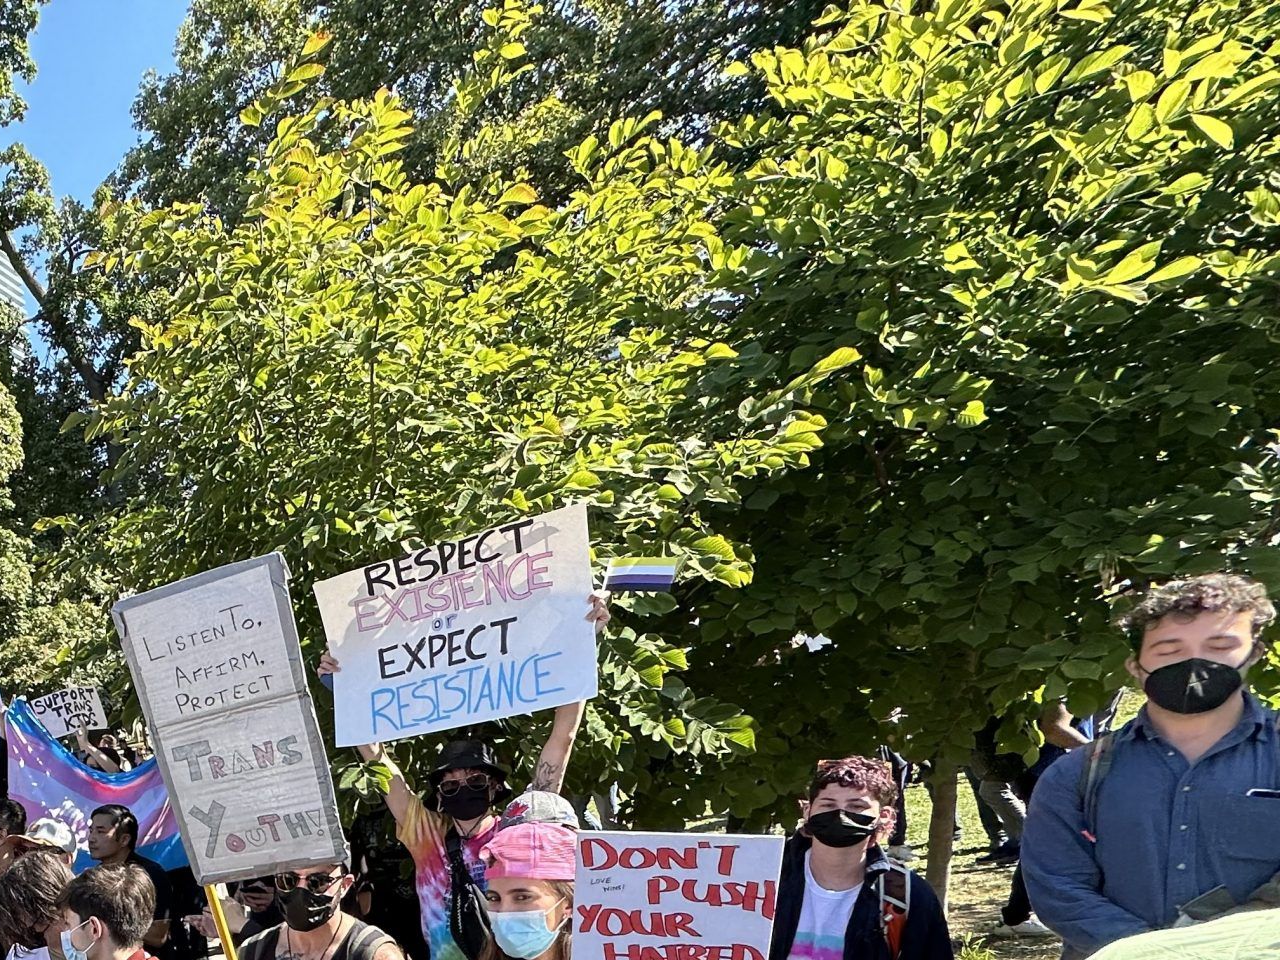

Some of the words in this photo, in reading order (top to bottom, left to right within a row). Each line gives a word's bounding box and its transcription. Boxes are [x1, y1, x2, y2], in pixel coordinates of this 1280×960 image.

[364, 519, 534, 596] RESPECT
[354, 551, 553, 632] EXISTENCE
[432, 613, 458, 630] or
[143, 625, 225, 661] LISTEN
[378, 617, 518, 680] EXPECT
[35, 689, 94, 714] SUPPORT
[52, 700, 93, 717] TRANS
[175, 675, 273, 714] PROTECT
[371, 652, 565, 735] RESISTANCE
[64, 713, 98, 731] KIDS
[172, 735, 303, 781] TRANS
[189, 800, 325, 858] YOUTH!
[580, 838, 740, 876] DON'T
[590, 877, 611, 885] LOVE
[647, 875, 775, 920] PUSH
[577, 904, 702, 937] YOUR
